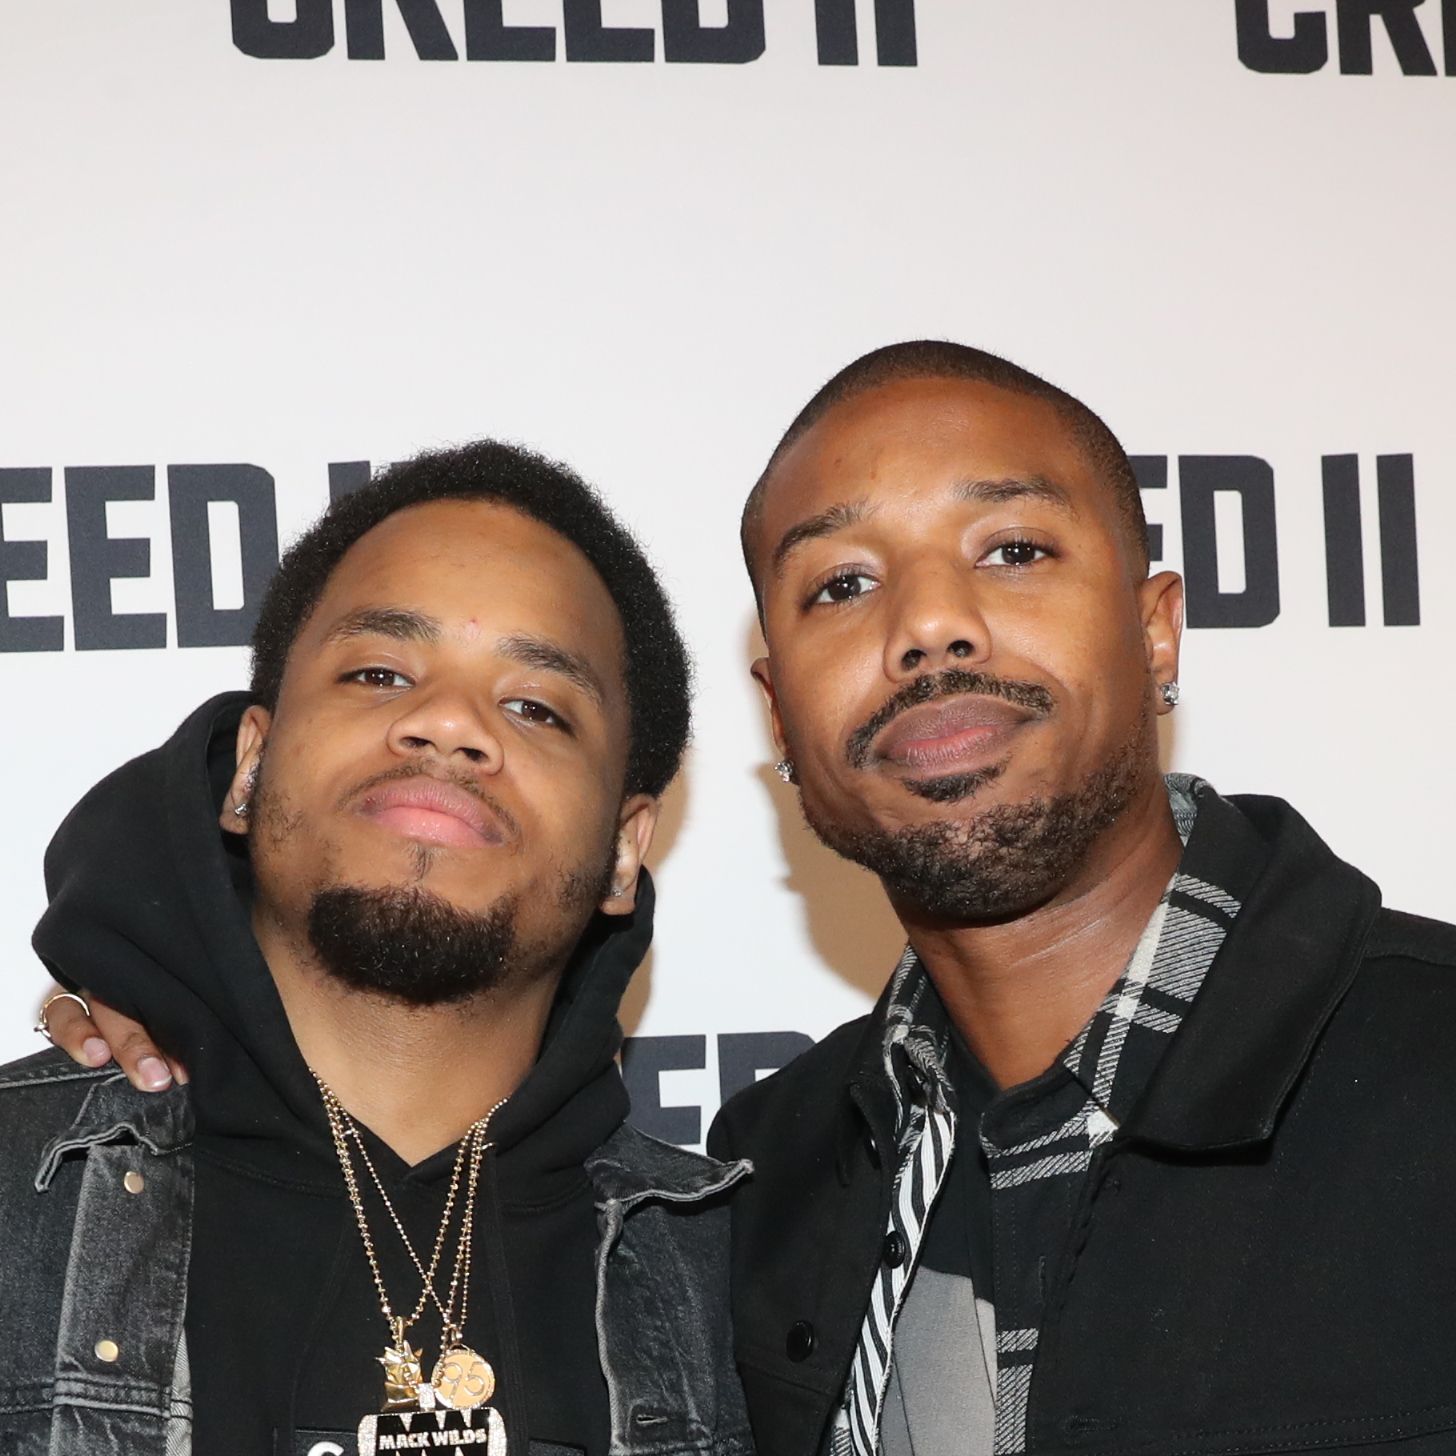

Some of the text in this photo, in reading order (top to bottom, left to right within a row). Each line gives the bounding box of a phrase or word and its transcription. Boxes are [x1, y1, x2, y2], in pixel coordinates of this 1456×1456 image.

[1320, 453, 1421, 627] II
[378, 1428, 487, 1451] MACK WILDS
